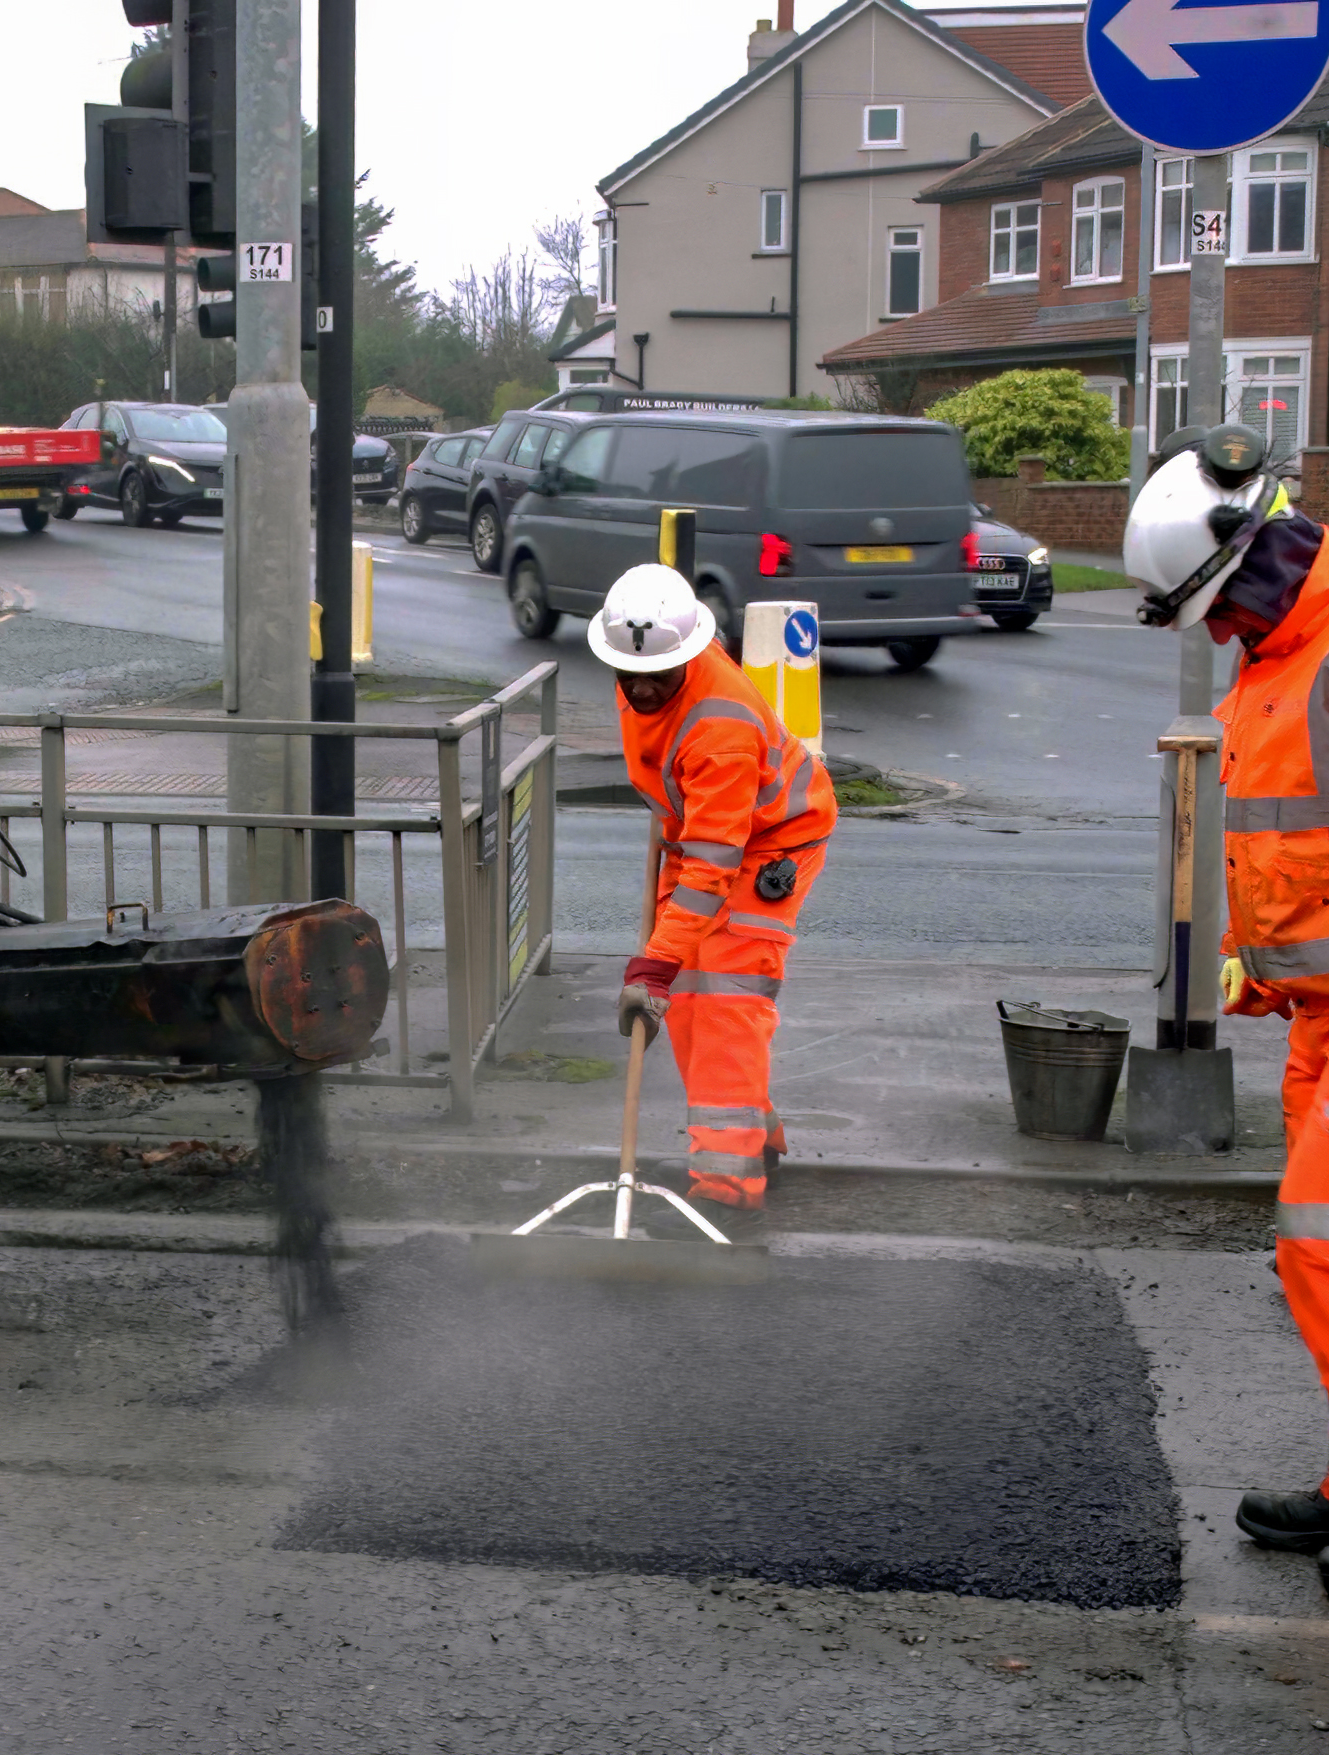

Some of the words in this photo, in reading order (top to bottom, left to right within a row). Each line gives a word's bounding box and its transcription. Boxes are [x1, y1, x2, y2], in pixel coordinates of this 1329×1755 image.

[246, 245, 282, 266] 171
[250, 268, 279, 279] S144
[623, 398, 652, 408] PAUL
[654, 400, 692, 411] BRADY
